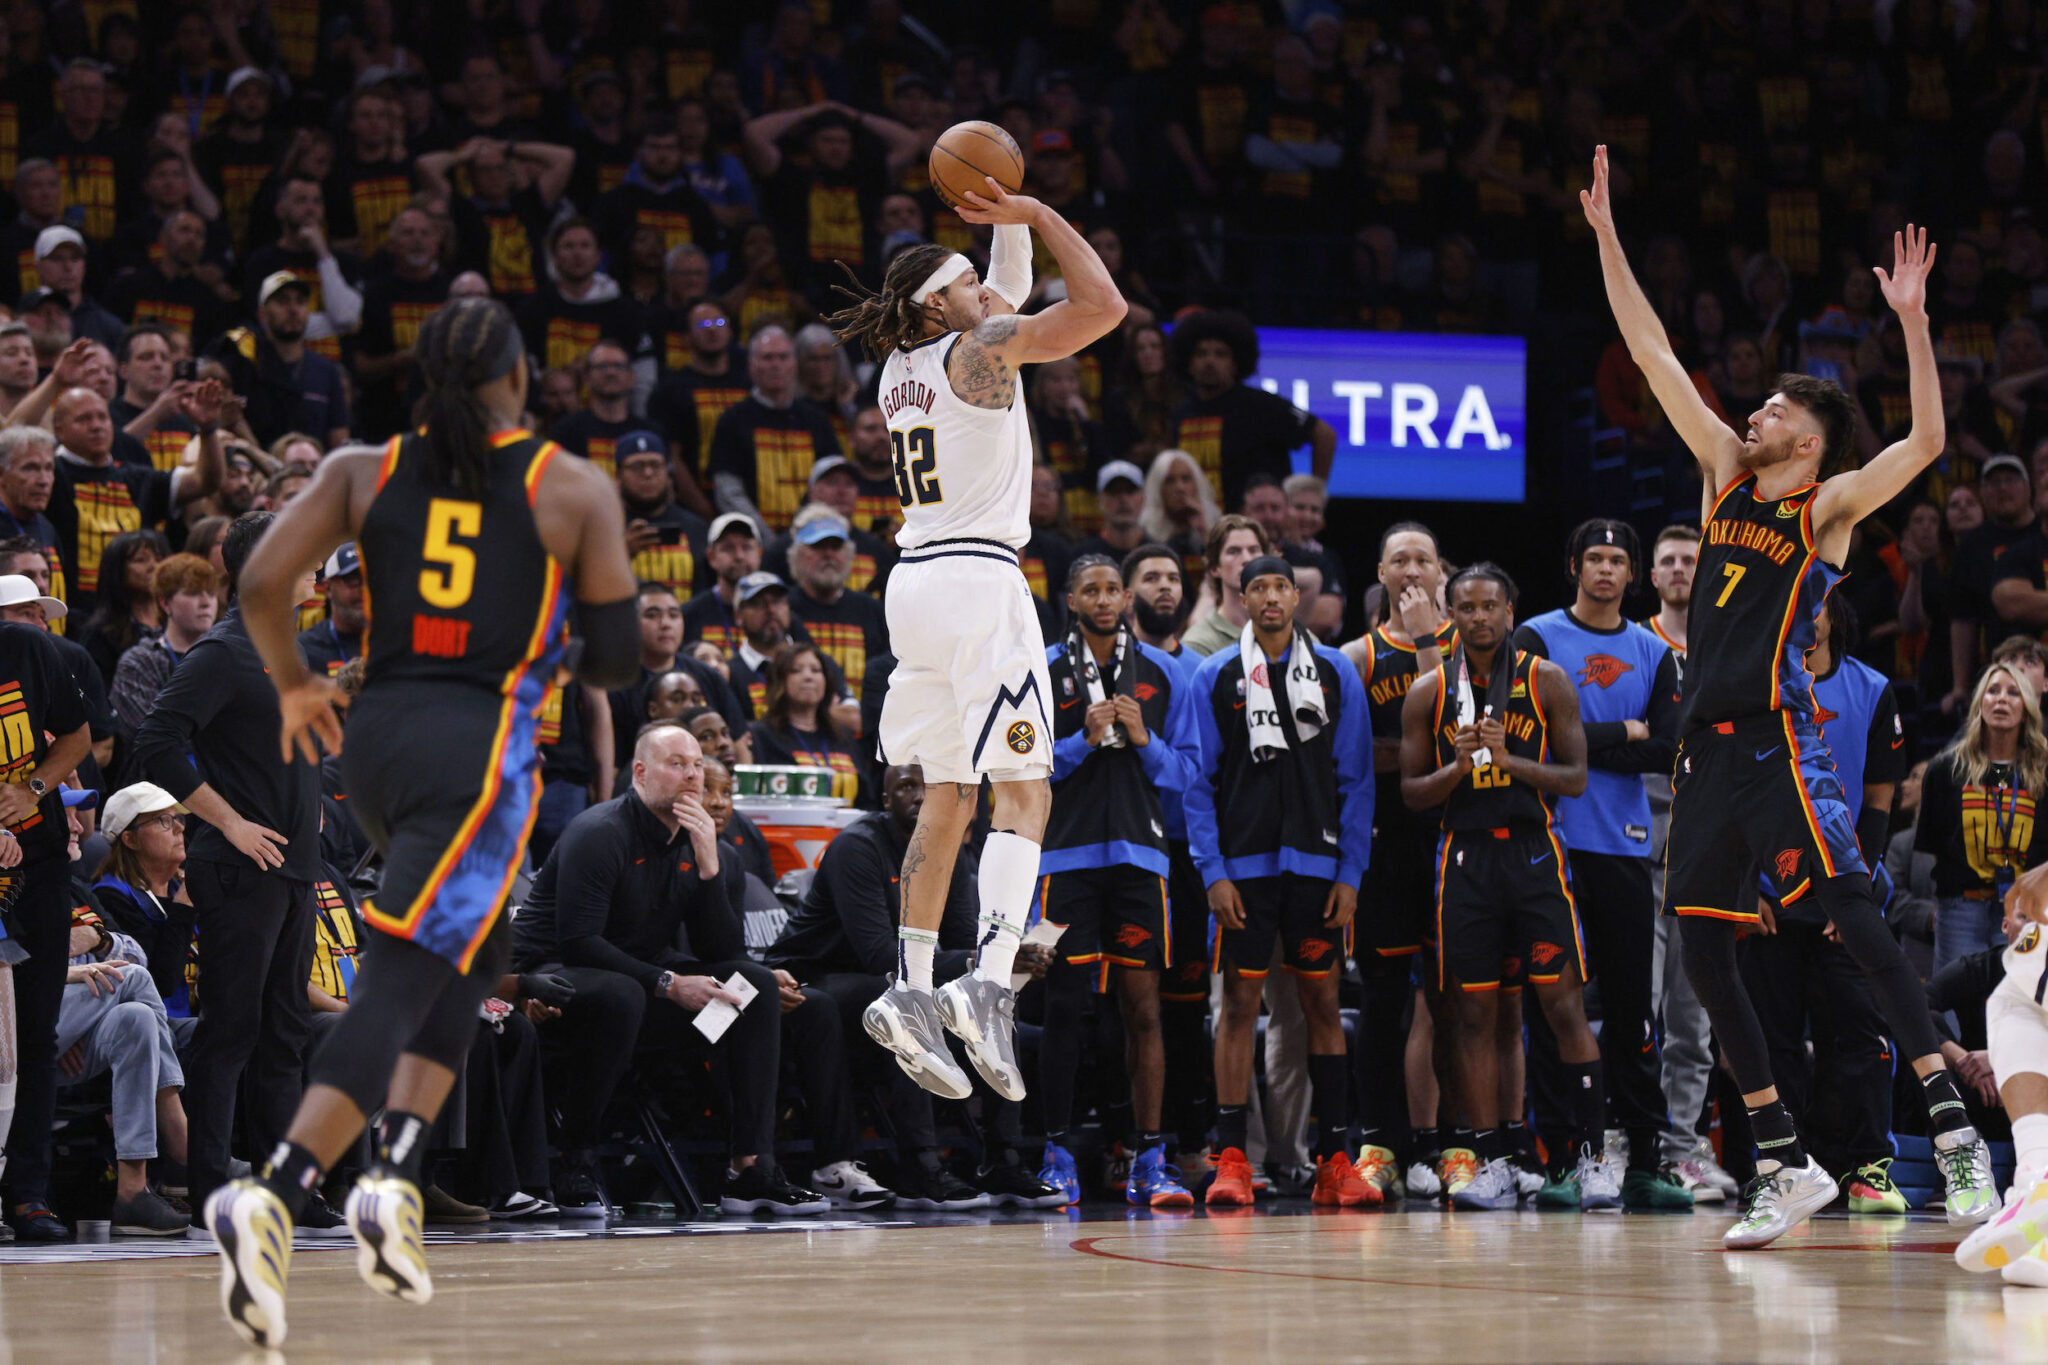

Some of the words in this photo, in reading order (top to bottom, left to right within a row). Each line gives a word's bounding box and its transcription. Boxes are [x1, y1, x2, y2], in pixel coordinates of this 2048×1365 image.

[884, 380, 936, 420] GORDON
[1261, 377, 1501, 450] TRA
[891, 426, 943, 508] 32
[418, 497, 483, 610] 5
[1713, 562, 1747, 608] 7
